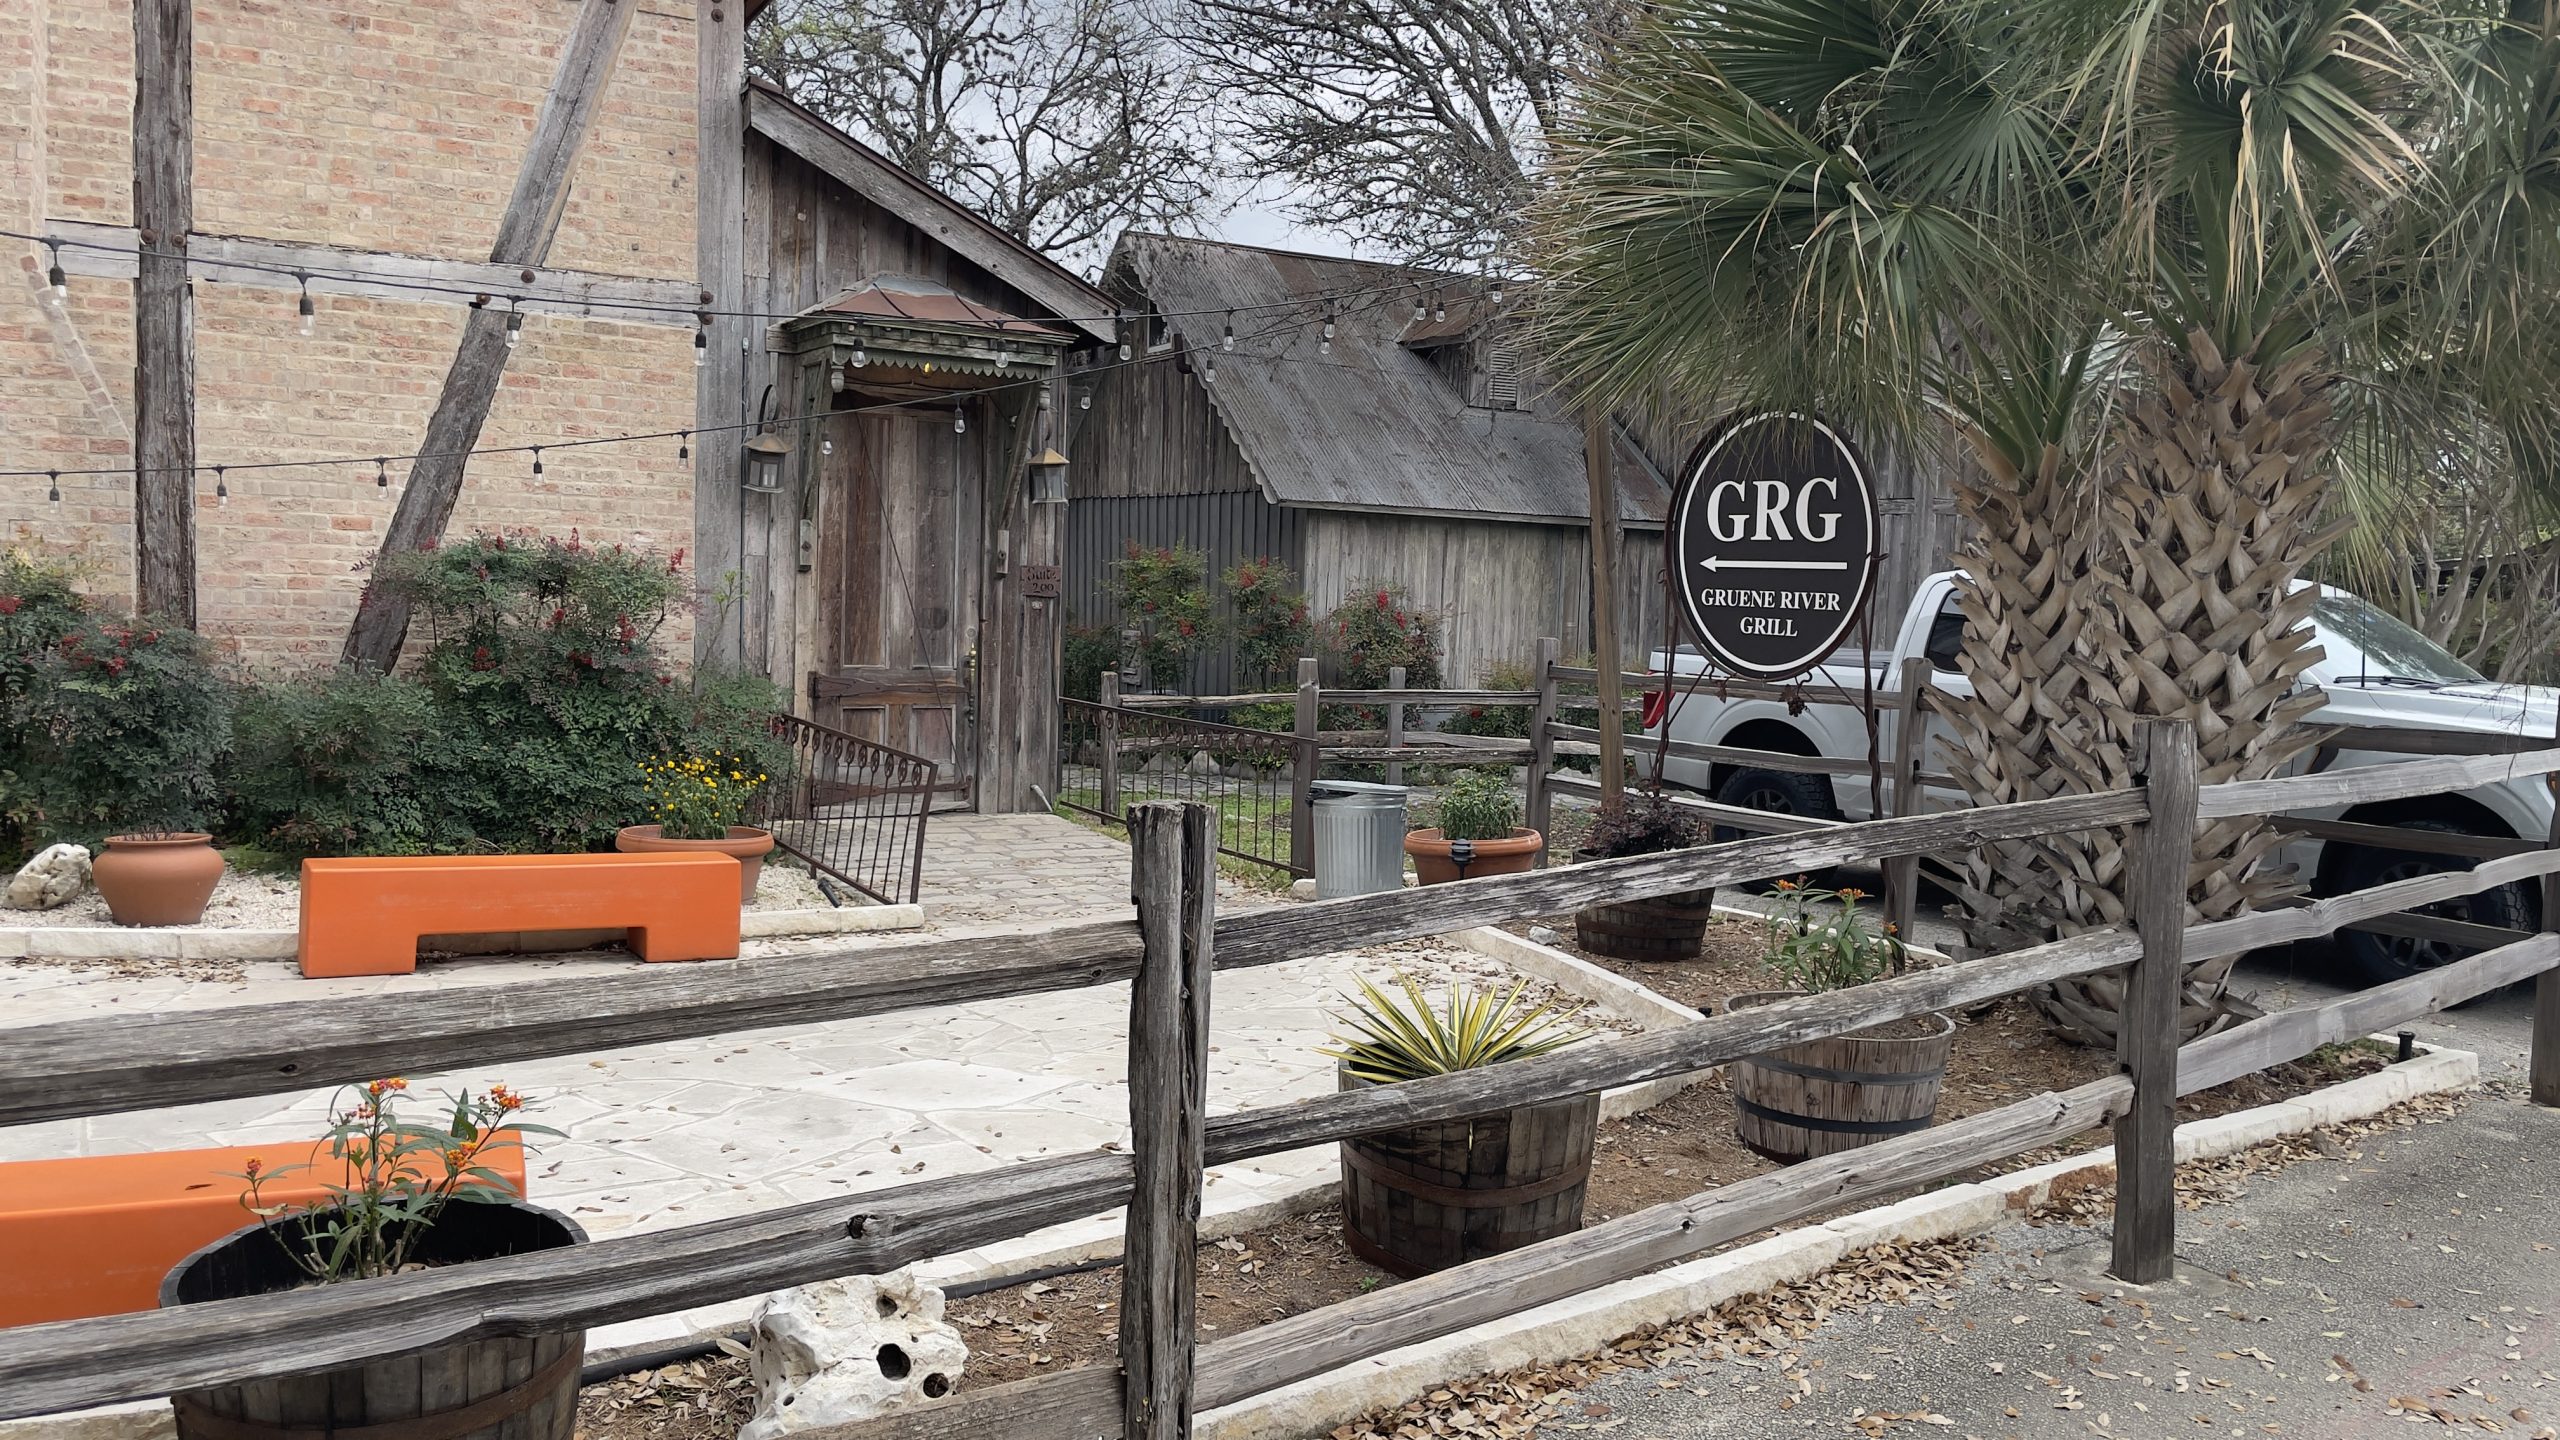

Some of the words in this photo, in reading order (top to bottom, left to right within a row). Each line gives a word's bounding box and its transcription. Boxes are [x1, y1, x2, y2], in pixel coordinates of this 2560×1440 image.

[1707, 477, 1842, 543] GRG
[1027, 566, 1057, 581] Suite
[1032, 583, 1054, 593] 200
[1701, 588, 1776, 609] GRUENE
[1780, 591, 1841, 611] RIVER
[1740, 616, 1798, 637] GRILL
